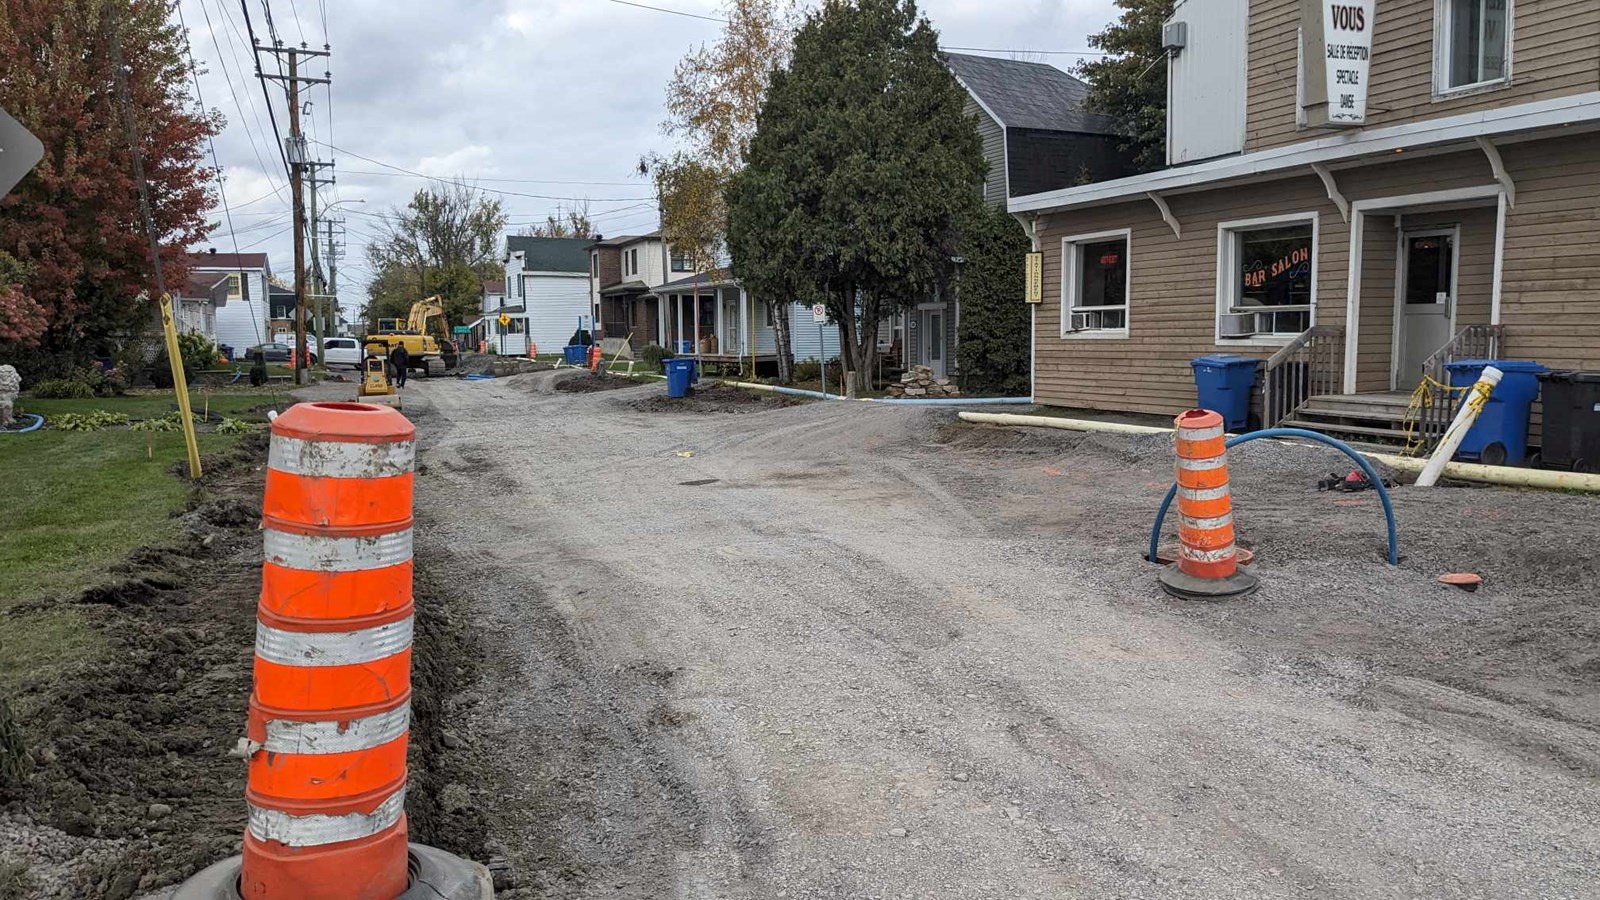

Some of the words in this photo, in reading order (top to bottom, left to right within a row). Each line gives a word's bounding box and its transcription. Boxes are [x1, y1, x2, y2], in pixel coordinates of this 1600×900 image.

[1331, 4, 1365, 31] VOUS
[1327, 43, 1339, 59] SALLE
[1340, 44, 1346, 59] DE
[1336, 69, 1359, 85] SPECTACLE
[1340, 93, 1354, 108] DANSE
[1245, 269, 1266, 287] BAR
[1271, 247, 1309, 277] SALON
